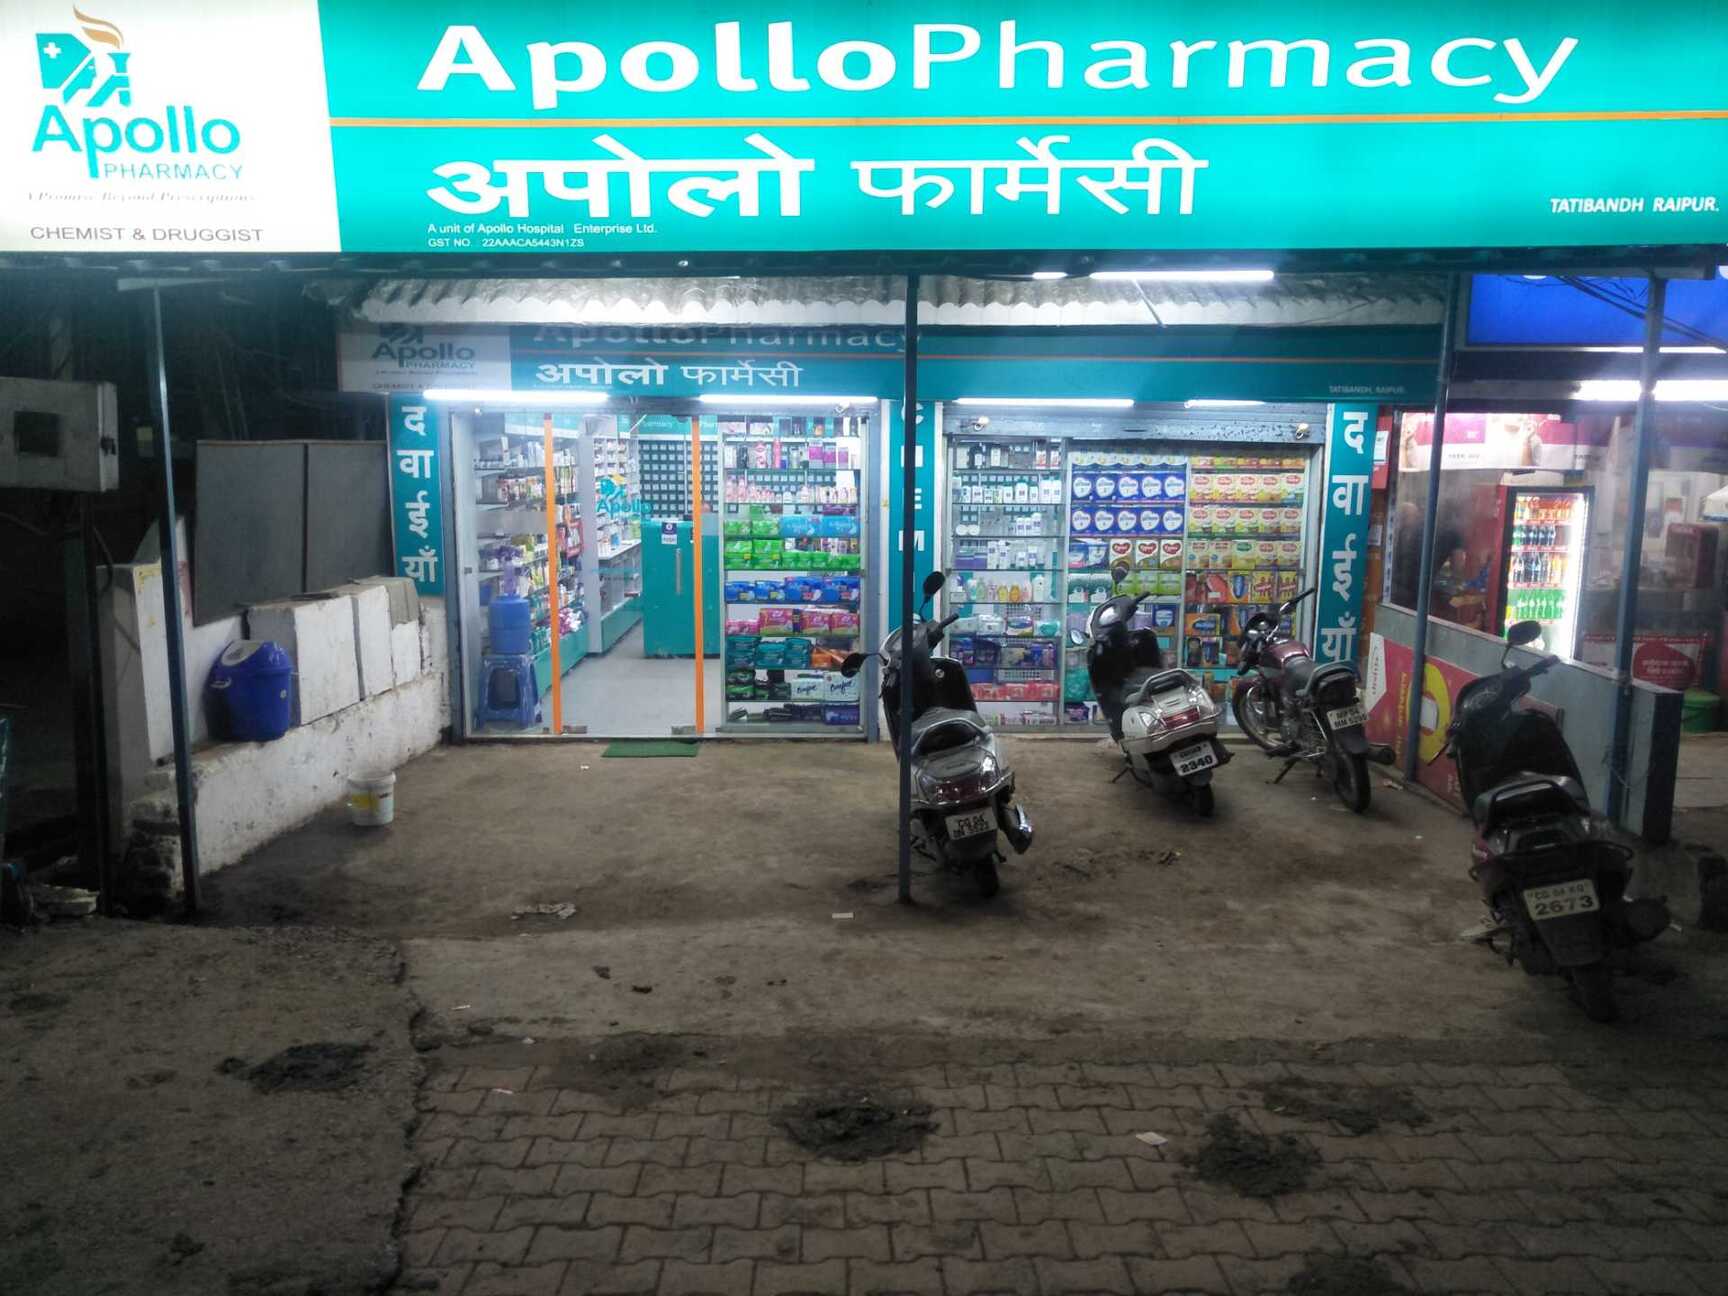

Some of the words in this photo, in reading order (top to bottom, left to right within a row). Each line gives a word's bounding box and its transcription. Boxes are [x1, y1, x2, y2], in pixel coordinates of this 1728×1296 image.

[32, 105, 241, 179] Apollo
[103, 162, 244, 181] PHARMACY
[426, 133, 816, 218] अपोलो
[850, 135, 1210, 216] फार्मेसी
[1550, 197, 1644, 214] TATIBANDH
[1652, 196, 1720, 213] RAIPUR.
[30, 226, 126, 241] CHEMIST
[132, 228, 146, 241] &
[152, 228, 265, 242] DRUGGIST
[427, 224, 437, 234] A
[439, 224, 460, 234] unit
[464, 224, 474, 234] of
[477, 224, 514, 236] Apollo
[517, 224, 564, 236] Hospital
[574, 224, 633, 236] Enterprise
[636, 224, 658, 234] Ltd.
[428, 238, 451, 248] GST
[371, 341, 475, 369] Apollo
[535, 356, 669, 385] अपोलो
[680, 359, 804, 387] फार्मेसी
[1535, 895, 1594, 916] 2673
